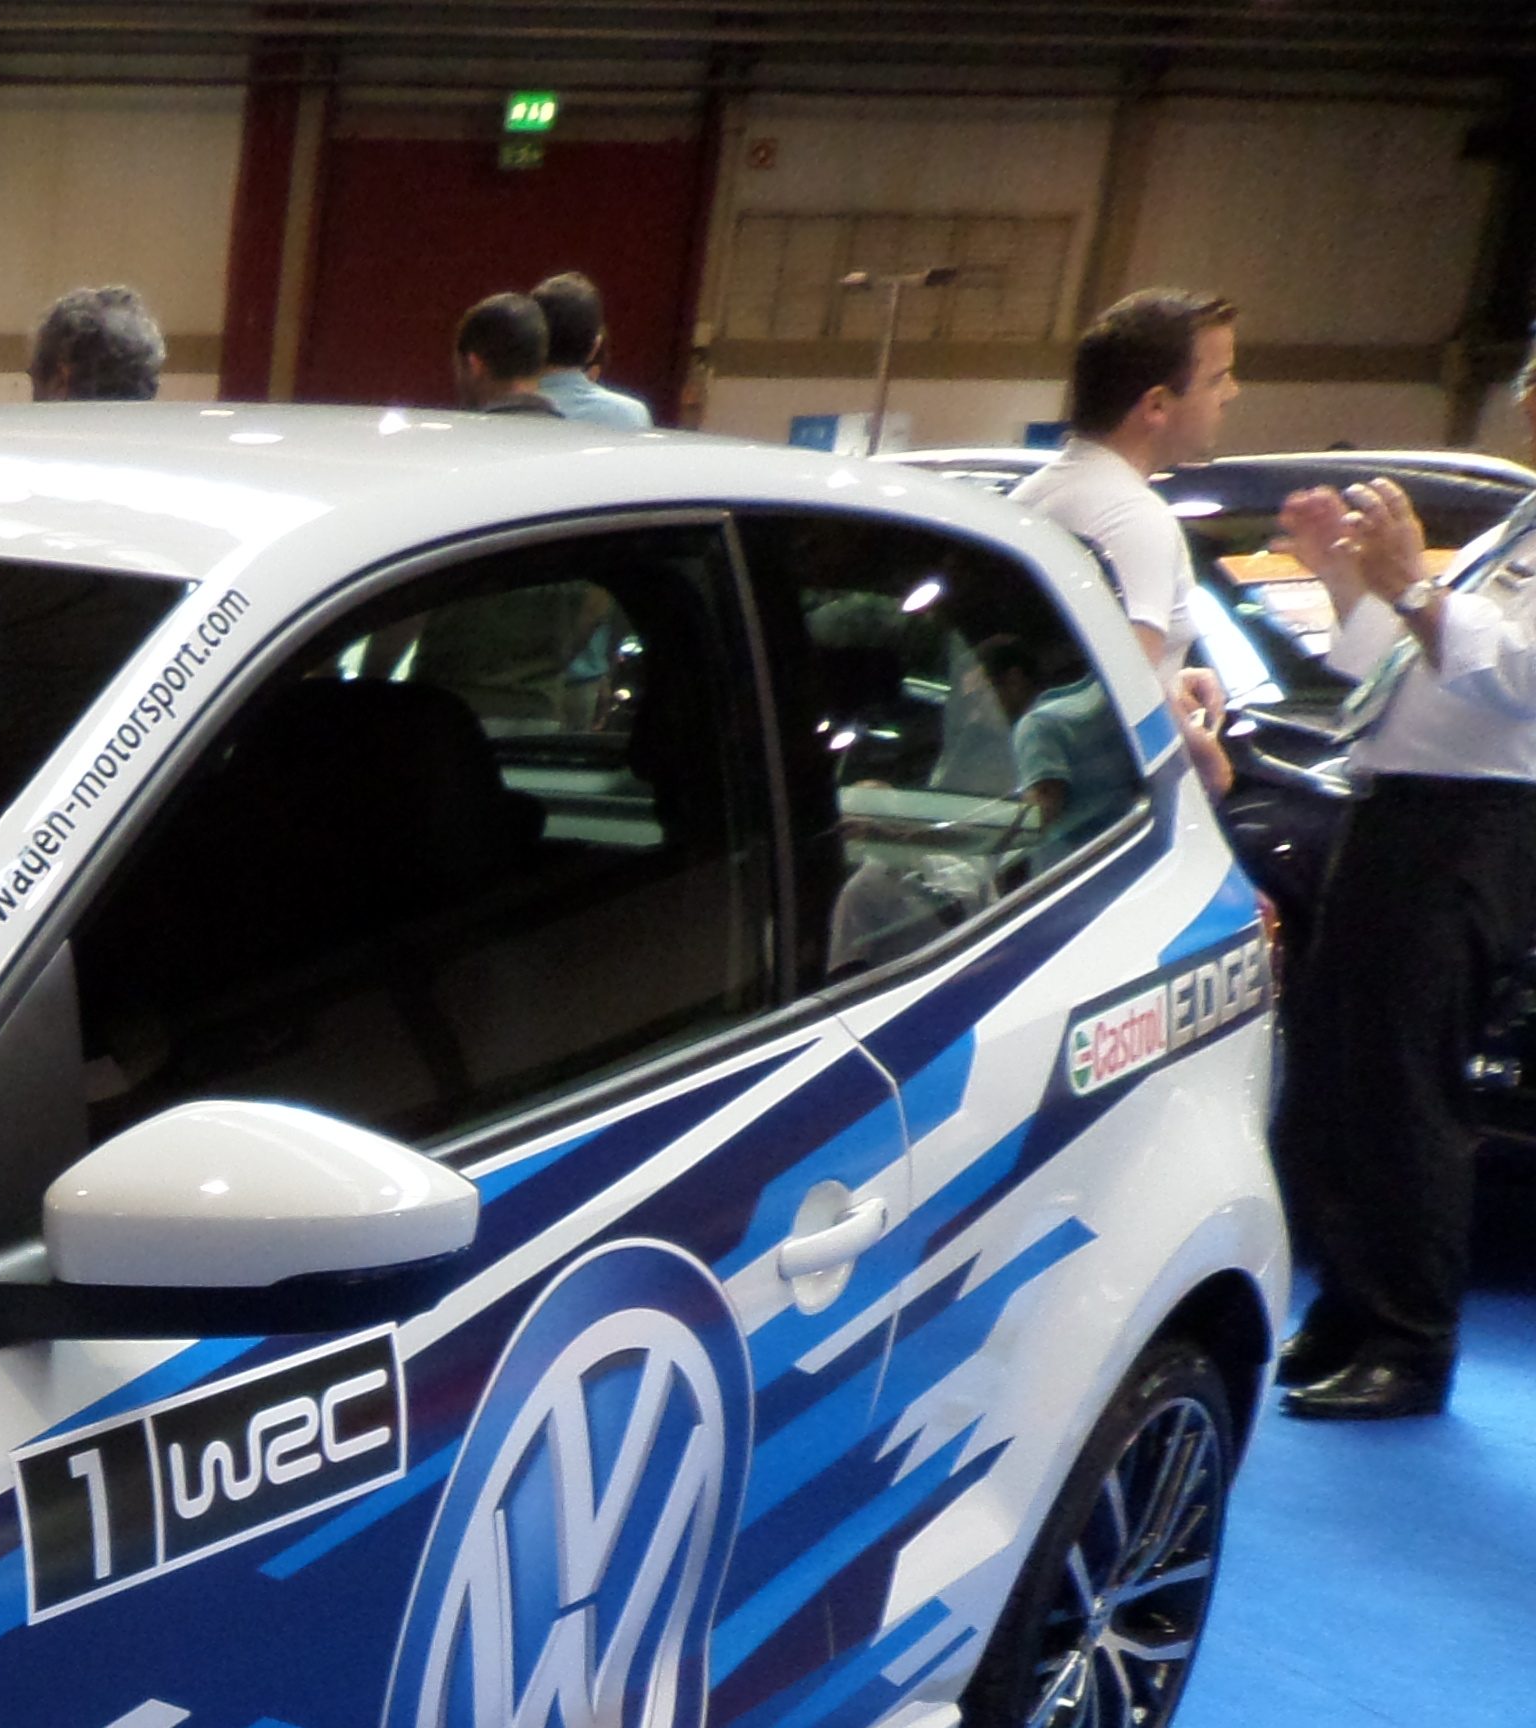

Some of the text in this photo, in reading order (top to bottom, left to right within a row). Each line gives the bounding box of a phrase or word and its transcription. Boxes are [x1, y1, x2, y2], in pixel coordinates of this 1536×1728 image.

[1093, 938, 1264, 1082] Castrol EDGE
[69, 1367, 392, 1580] 1 WRC
